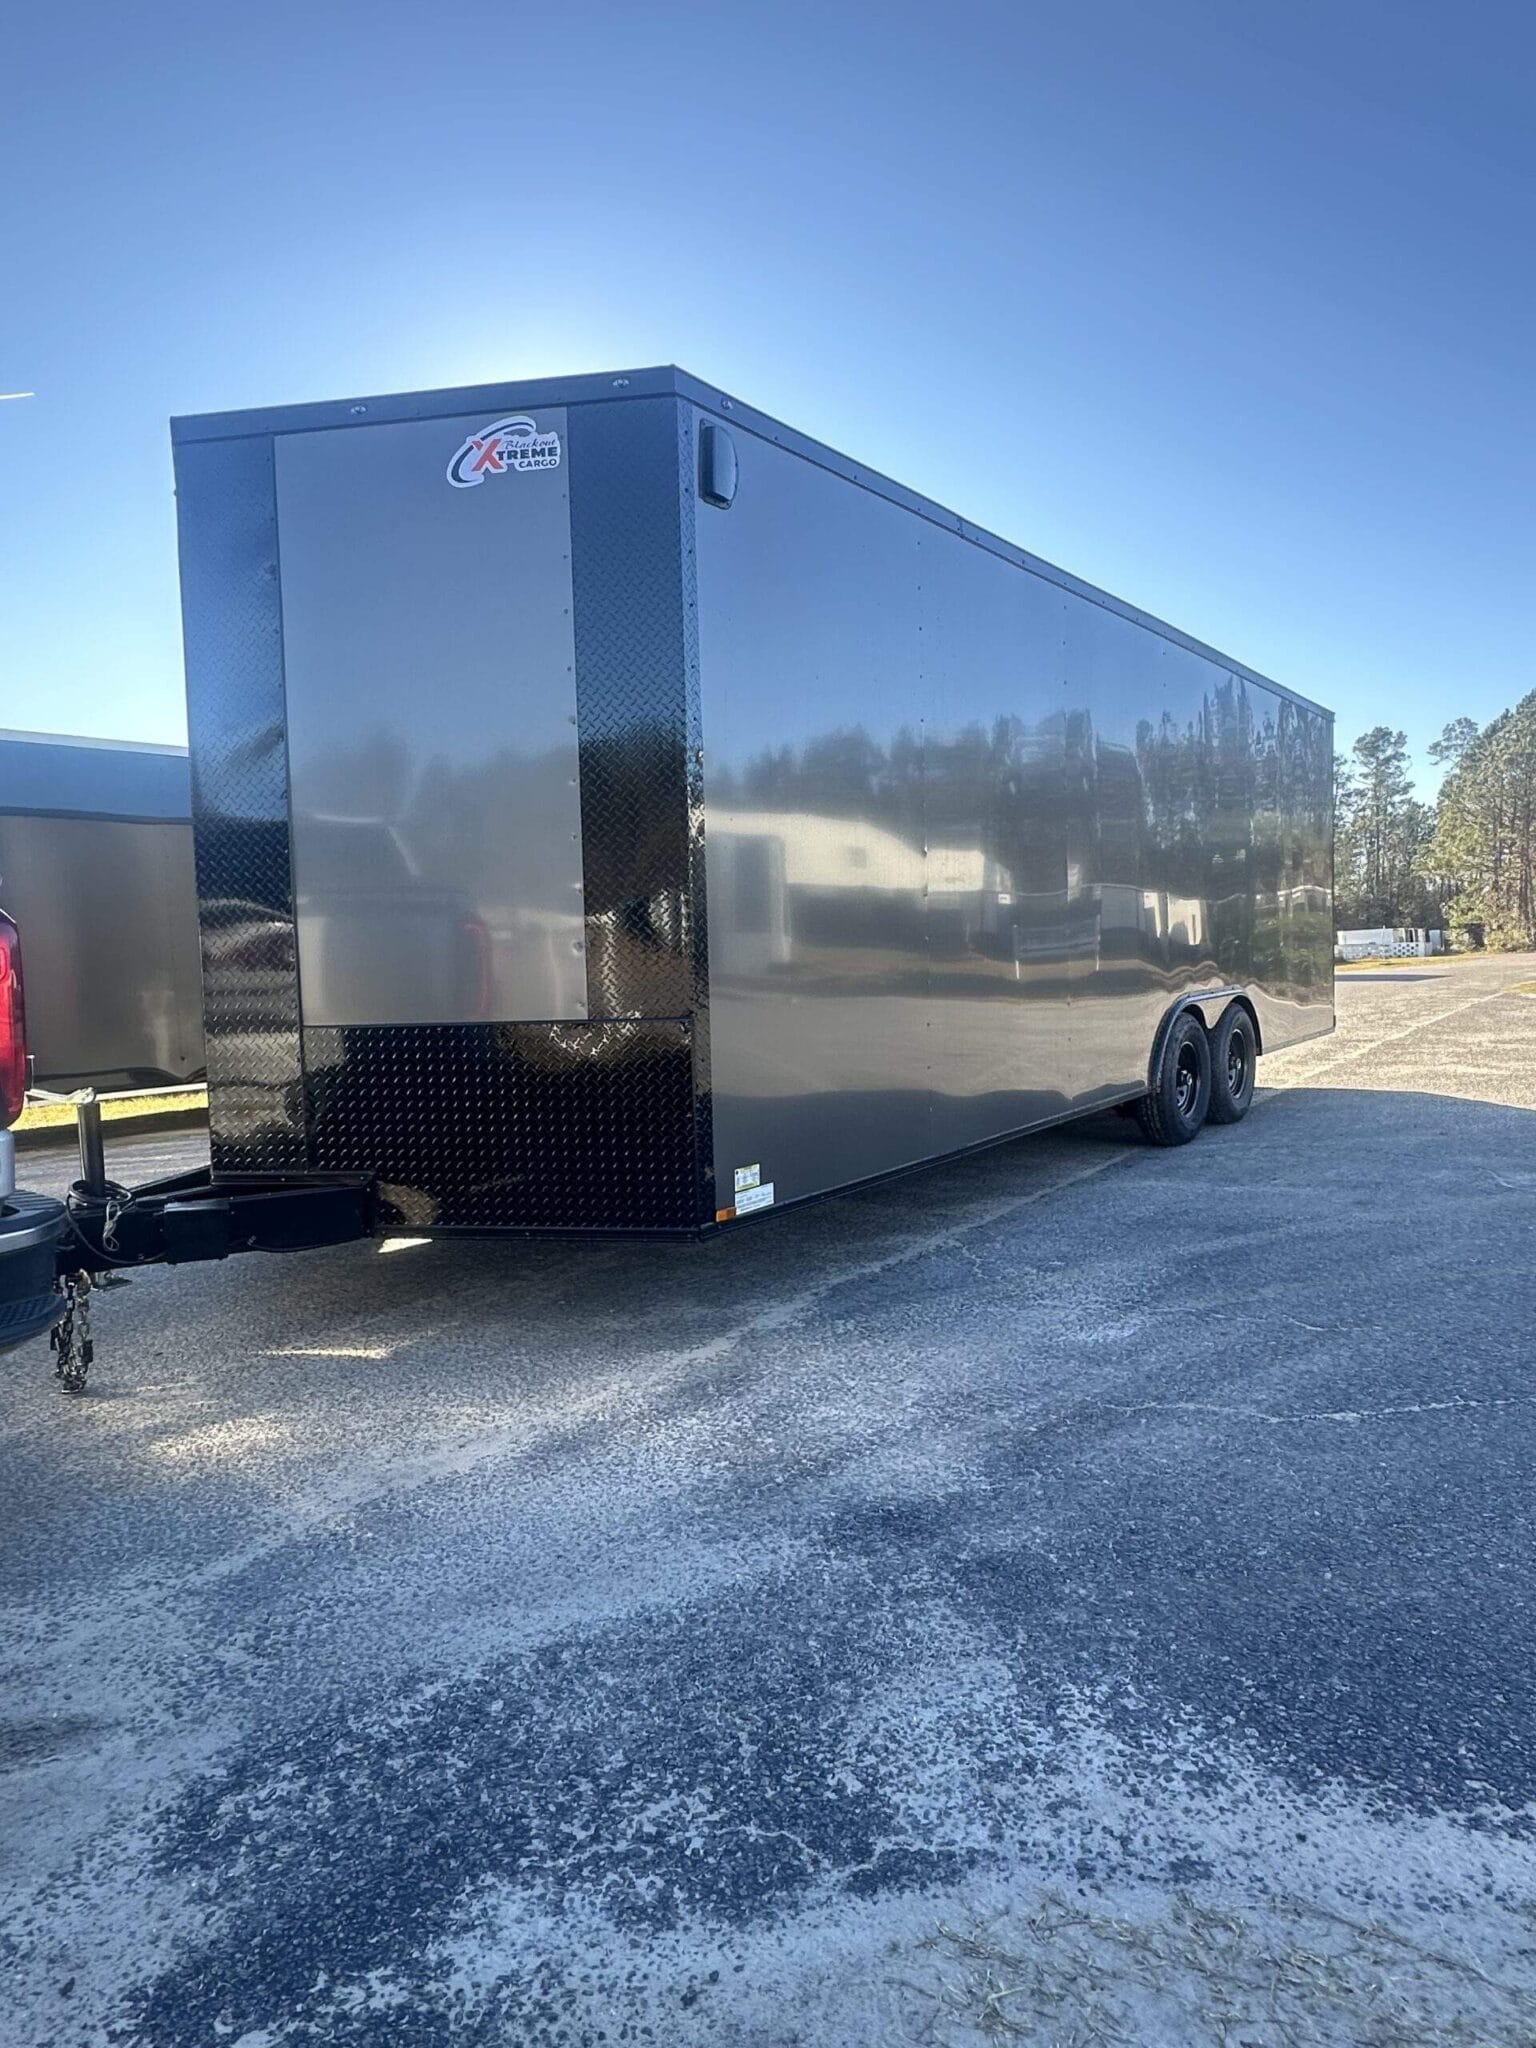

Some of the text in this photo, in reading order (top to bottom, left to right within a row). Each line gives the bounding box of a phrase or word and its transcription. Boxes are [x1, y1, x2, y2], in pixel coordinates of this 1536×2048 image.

[505, 438, 556, 450] Blackout
[471, 438, 558, 472] XTREME
[518, 458, 557, 469] CARGO
